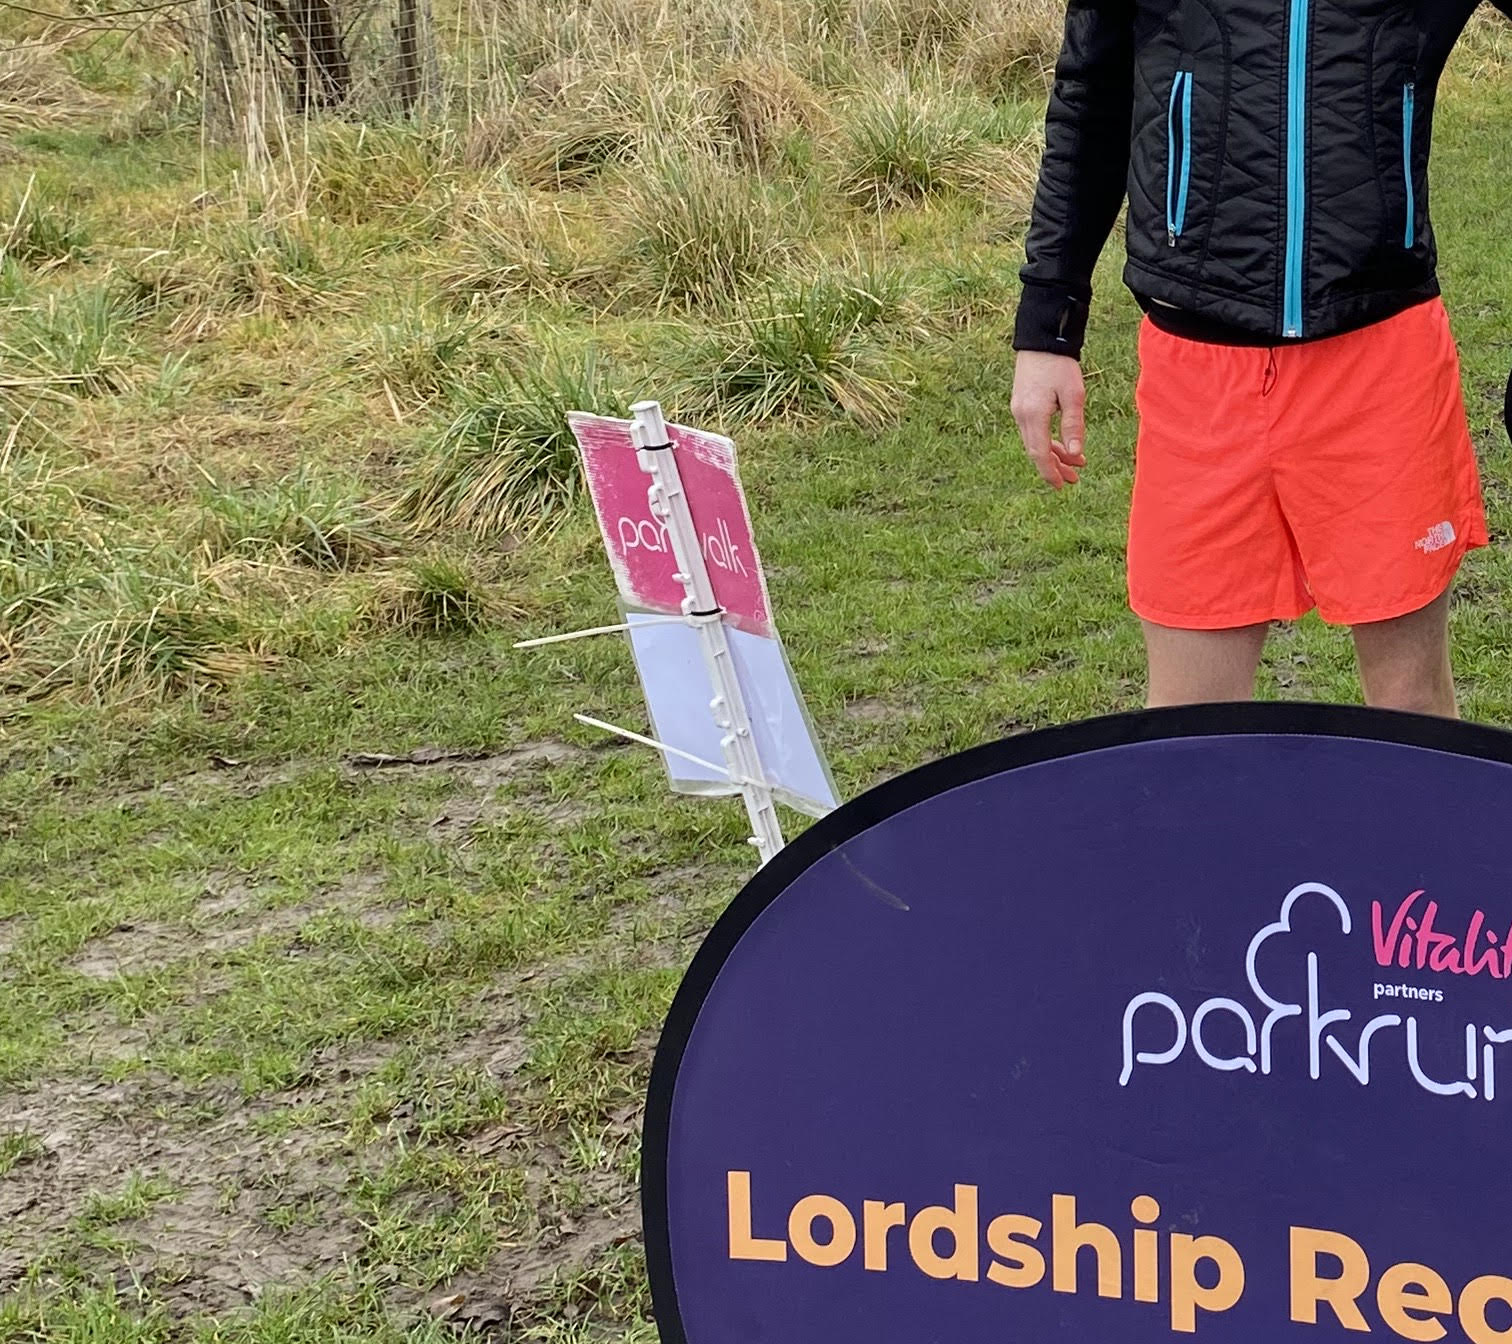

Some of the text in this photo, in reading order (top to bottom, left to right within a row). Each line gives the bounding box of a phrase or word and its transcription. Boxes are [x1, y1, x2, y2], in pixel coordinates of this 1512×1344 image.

[617, 516, 749, 578] paralk
[1373, 981, 1445, 1003] partners
[727, 1170, 1246, 1333] Lordship
